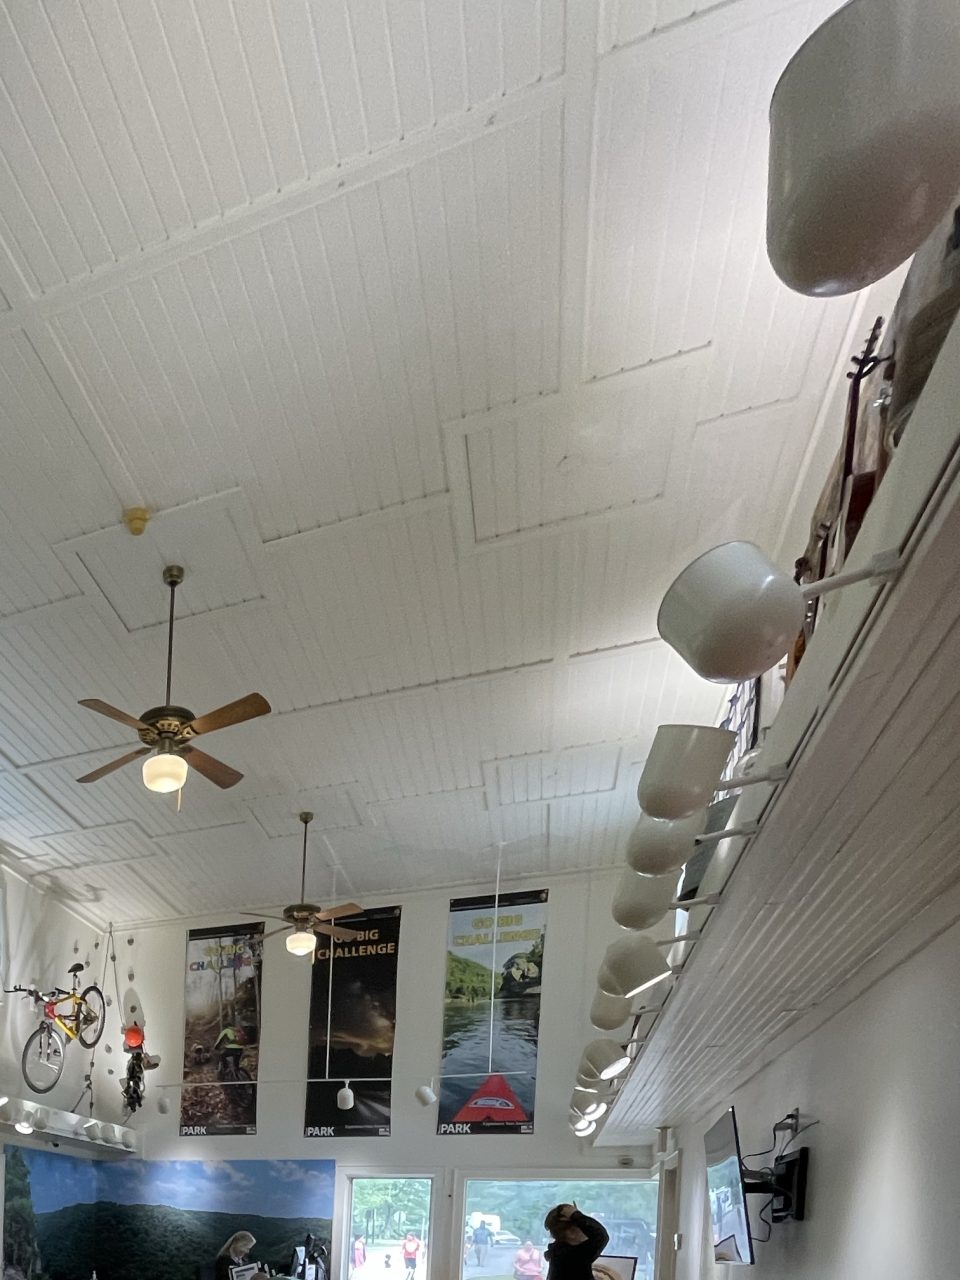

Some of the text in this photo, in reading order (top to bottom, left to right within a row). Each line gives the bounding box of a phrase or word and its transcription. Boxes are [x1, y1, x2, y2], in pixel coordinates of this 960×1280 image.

[356, 929, 379, 941] BIG
[317, 942, 396, 960] CHALLENGE
[182, 1126, 207, 1135] PARK
[307, 1126, 335, 1136] PARK
[441, 1123, 471, 1134] PARK
